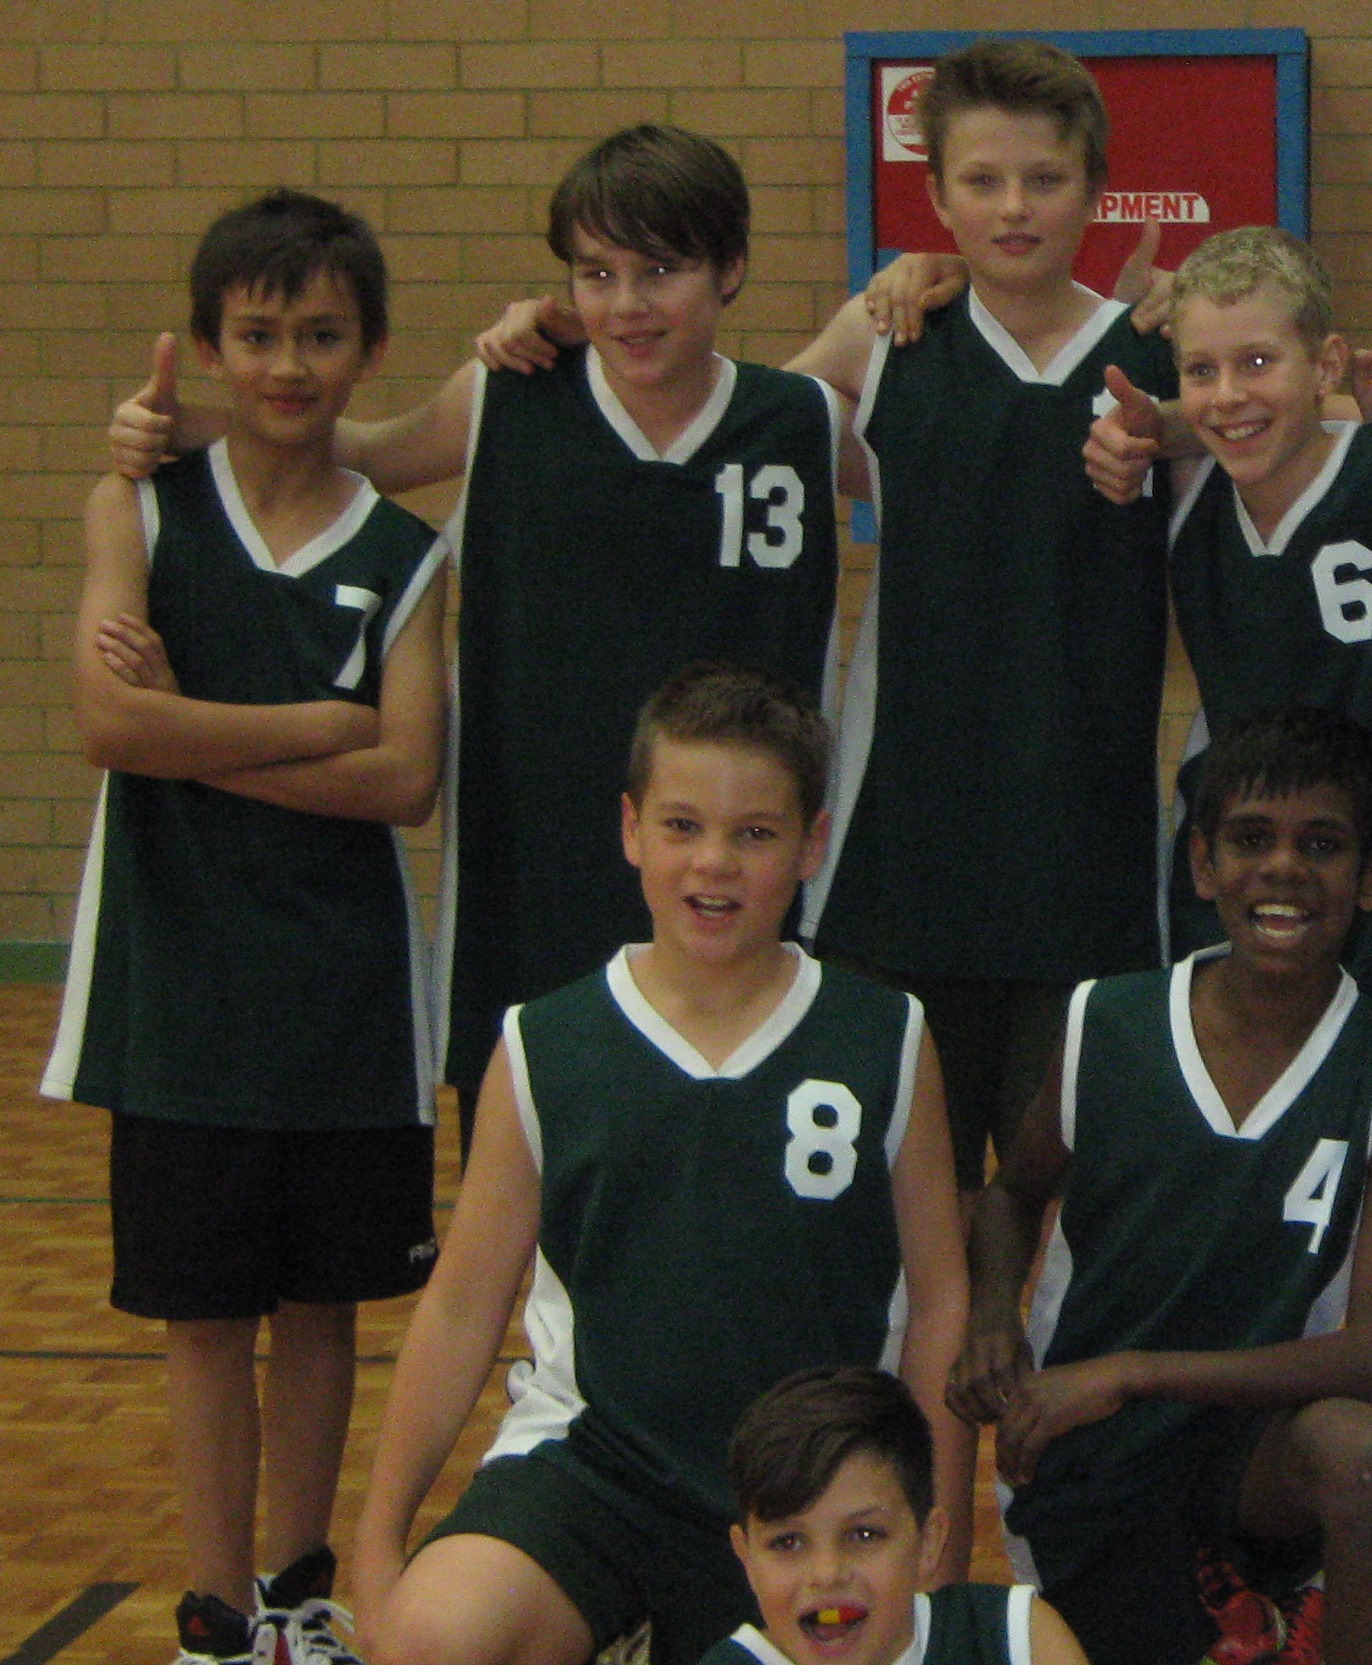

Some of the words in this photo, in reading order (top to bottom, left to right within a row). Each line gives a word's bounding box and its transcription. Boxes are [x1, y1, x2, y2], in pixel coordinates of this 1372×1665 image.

[1101, 195, 1200, 220] PMENT
[714, 463, 805, 569] 13
[333, 583, 382, 690] 7
[785, 1078, 862, 1200] 8
[1283, 1137, 1350, 1254] 4
